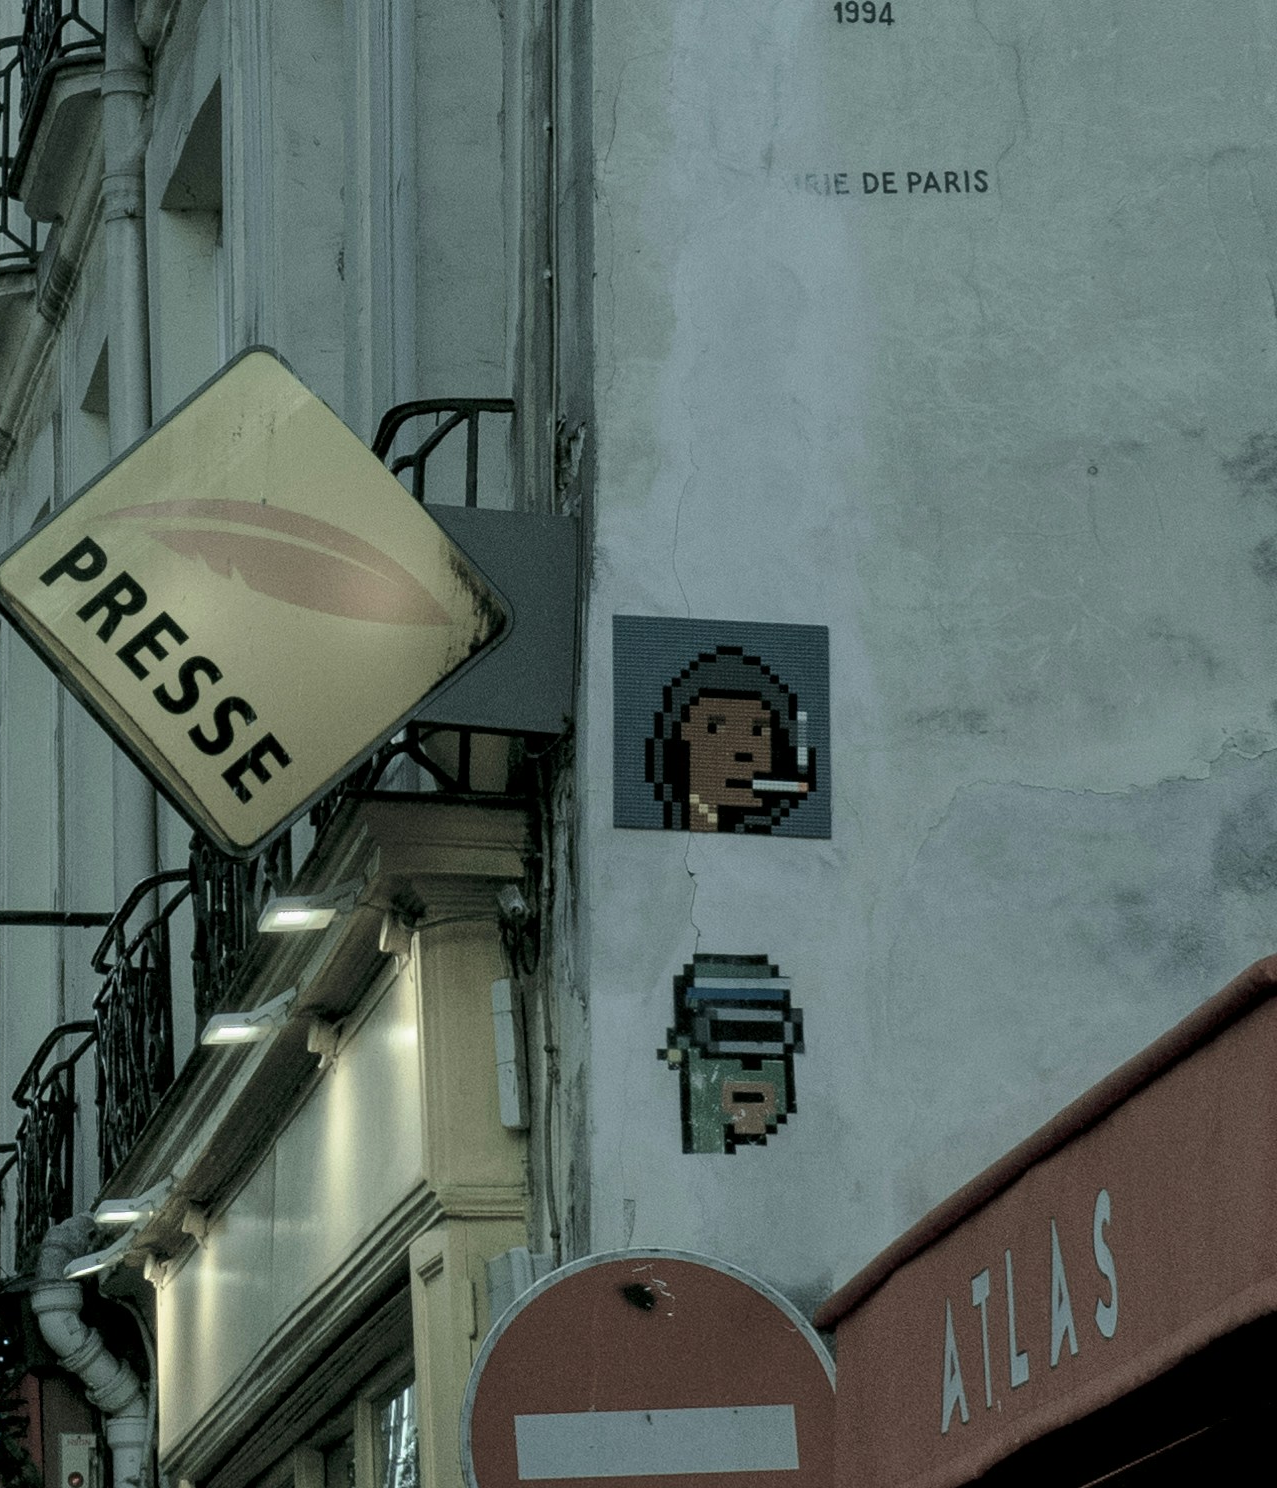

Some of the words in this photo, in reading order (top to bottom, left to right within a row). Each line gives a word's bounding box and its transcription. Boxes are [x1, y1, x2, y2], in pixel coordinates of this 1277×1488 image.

[833, 0, 895, 25] 1994
[862, 172, 898, 194] DE
[907, 169, 989, 194] PARIS
[39, 535, 293, 805] PRESSE
[941, 1188, 1119, 1435] ATLAS
